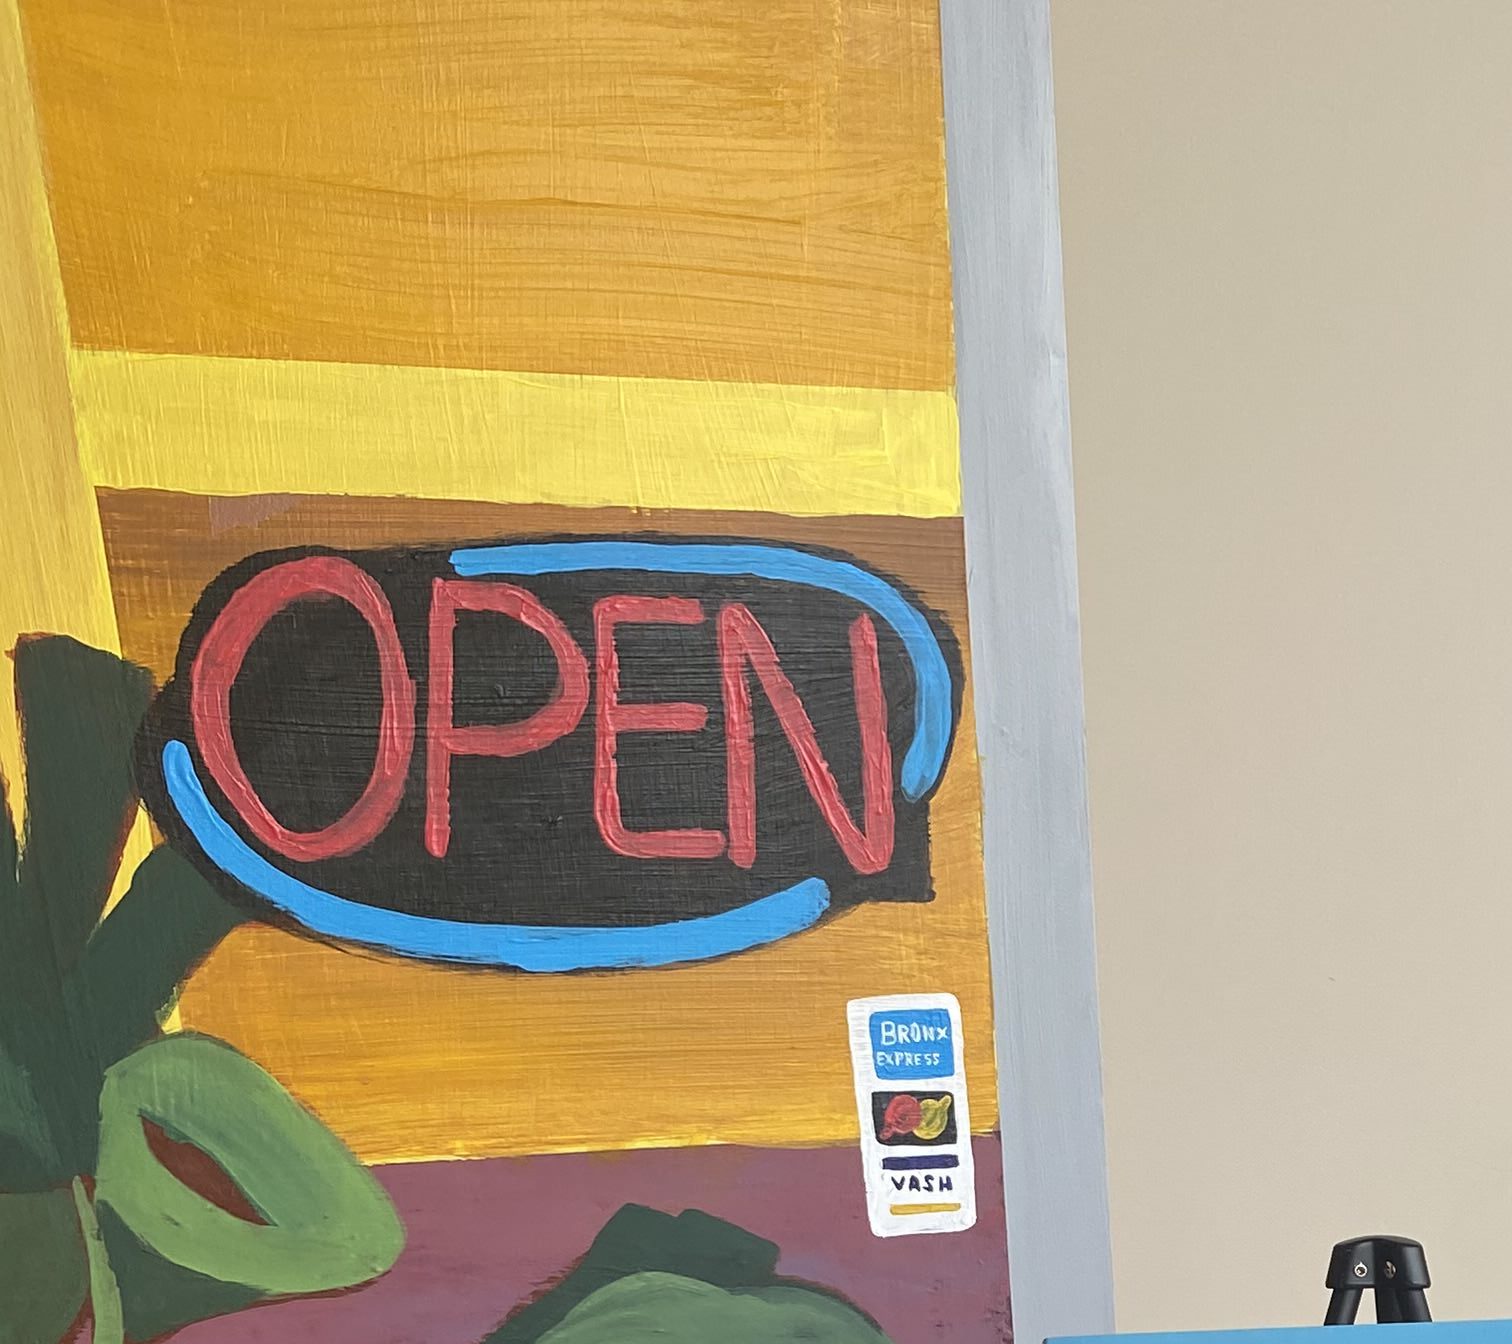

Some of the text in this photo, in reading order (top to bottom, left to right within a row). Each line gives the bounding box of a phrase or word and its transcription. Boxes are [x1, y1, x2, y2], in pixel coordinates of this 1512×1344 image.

[190, 556, 895, 875] OPEN
[876, 1051, 941, 1066] EXPRESS
[891, 1174, 953, 1192] VASH
